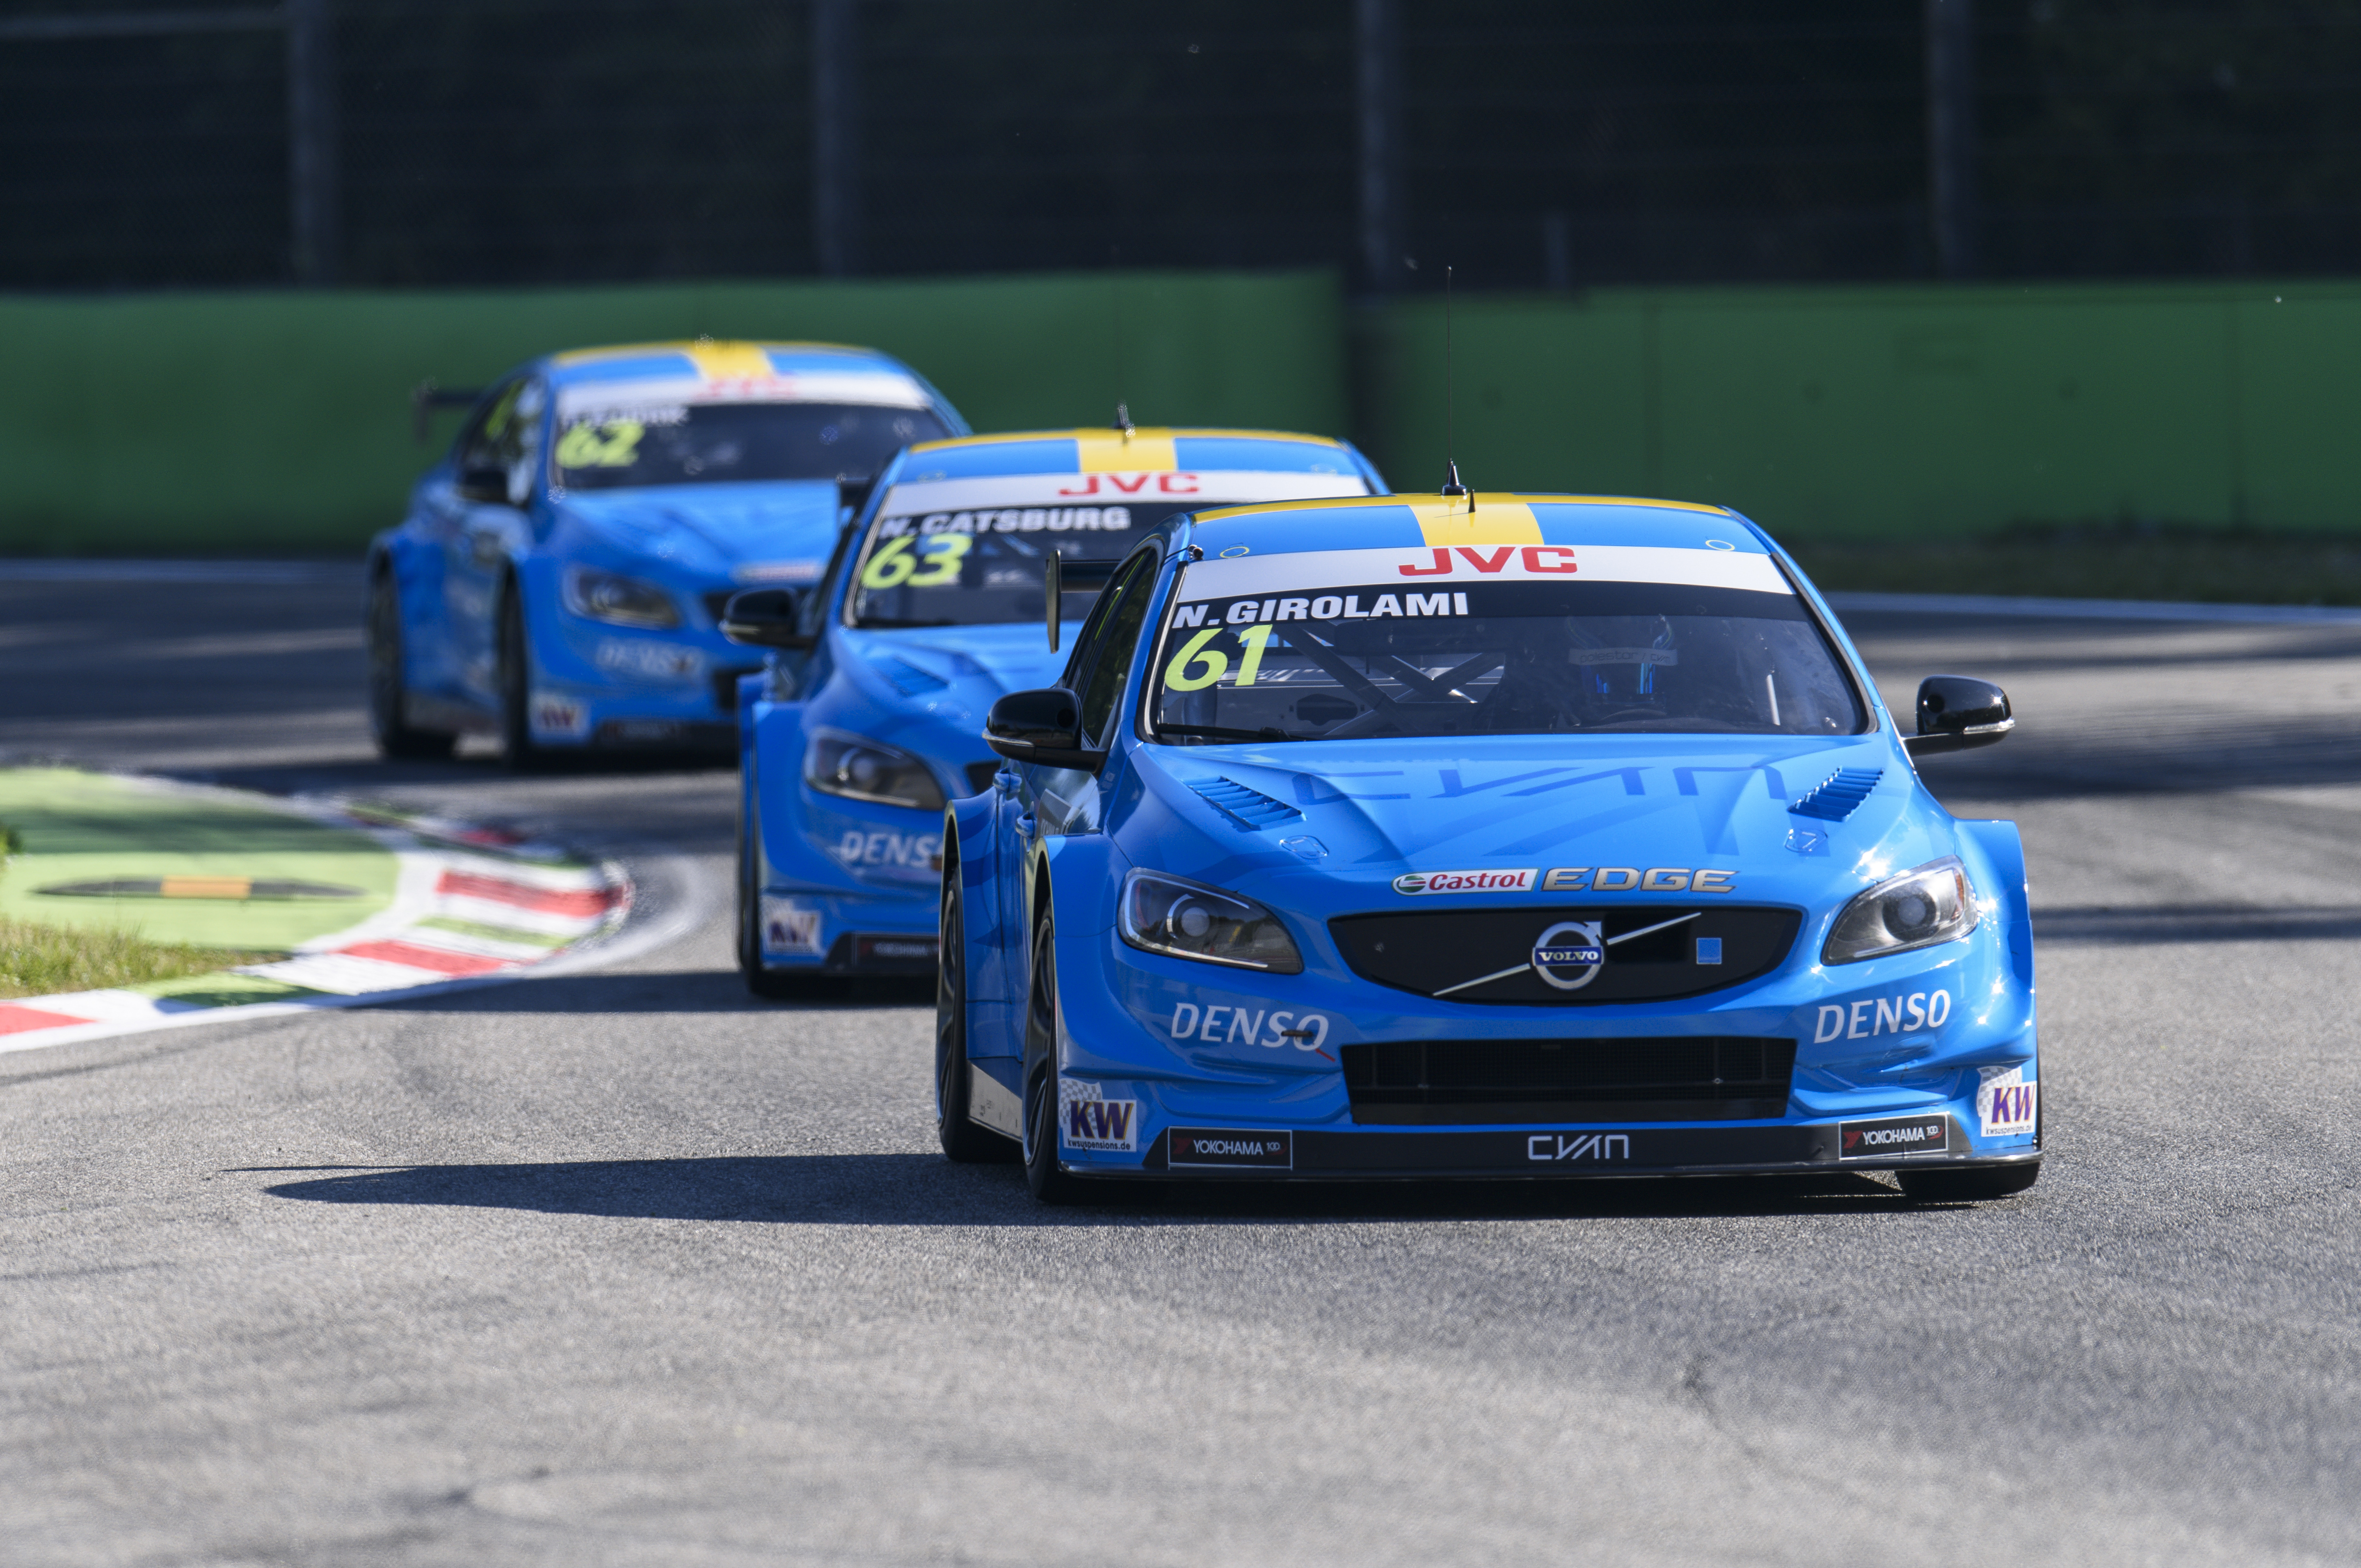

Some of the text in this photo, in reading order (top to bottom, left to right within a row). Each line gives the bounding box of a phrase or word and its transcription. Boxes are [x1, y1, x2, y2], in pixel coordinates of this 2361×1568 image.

[555, 418, 645, 469] 62
[1058, 471, 1199, 496] JVC
[860, 533, 973, 590] 63
[1399, 546, 1577, 576] JVC
[1172, 592, 1469, 629] N.GIROLAMI
[1164, 624, 1273, 692] 61
[1429, 867, 1740, 893] Castrol EDGE
[1538, 951, 1599, 962] VOLVO
[1171, 1002, 1329, 1051] DENSO
[1814, 989, 1951, 1043] DENSO
[1070, 1099, 1134, 1140] KW
[1991, 1084, 2036, 1125] KW
[1067, 1138, 1131, 1150] kwsuspensions.de
[1193, 1139, 1264, 1156] YOKOHAMA
[1863, 1127, 1925, 1145] YOKOHAMA
